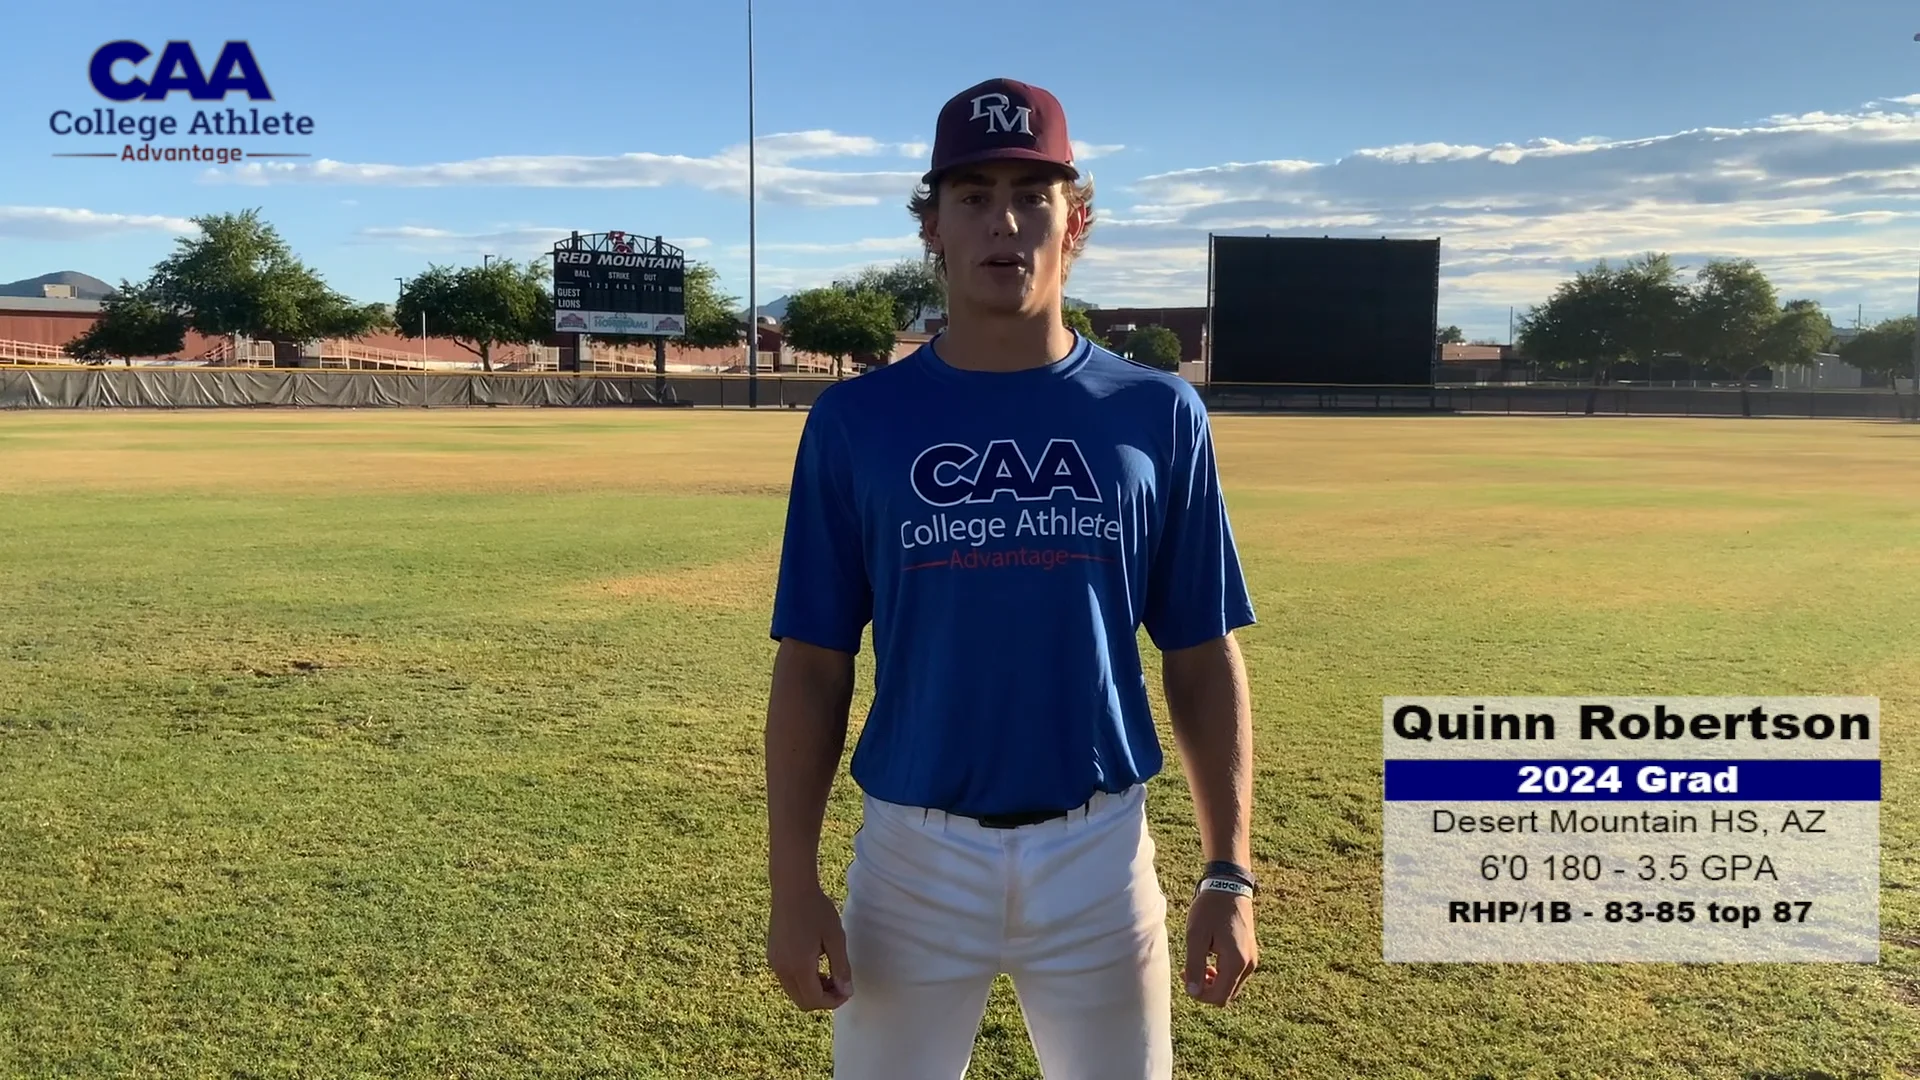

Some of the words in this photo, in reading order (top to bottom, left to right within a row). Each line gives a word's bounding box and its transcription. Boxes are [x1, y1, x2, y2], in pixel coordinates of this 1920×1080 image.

[557, 252, 592, 264] RED
[597, 254, 683, 269] MOUNTAIN
[574, 270, 591, 278] BALL
[608, 272, 631, 280] STRIKE
[644, 273, 657, 281] OUT
[557, 288, 581, 297] GUEST
[558, 299, 581, 309] LIONS
[910, 438, 1103, 507] CAA
[901, 513, 1006, 549] College
[1015, 507, 1121, 541] Athlete
[949, 548, 1069, 571] Advantage
